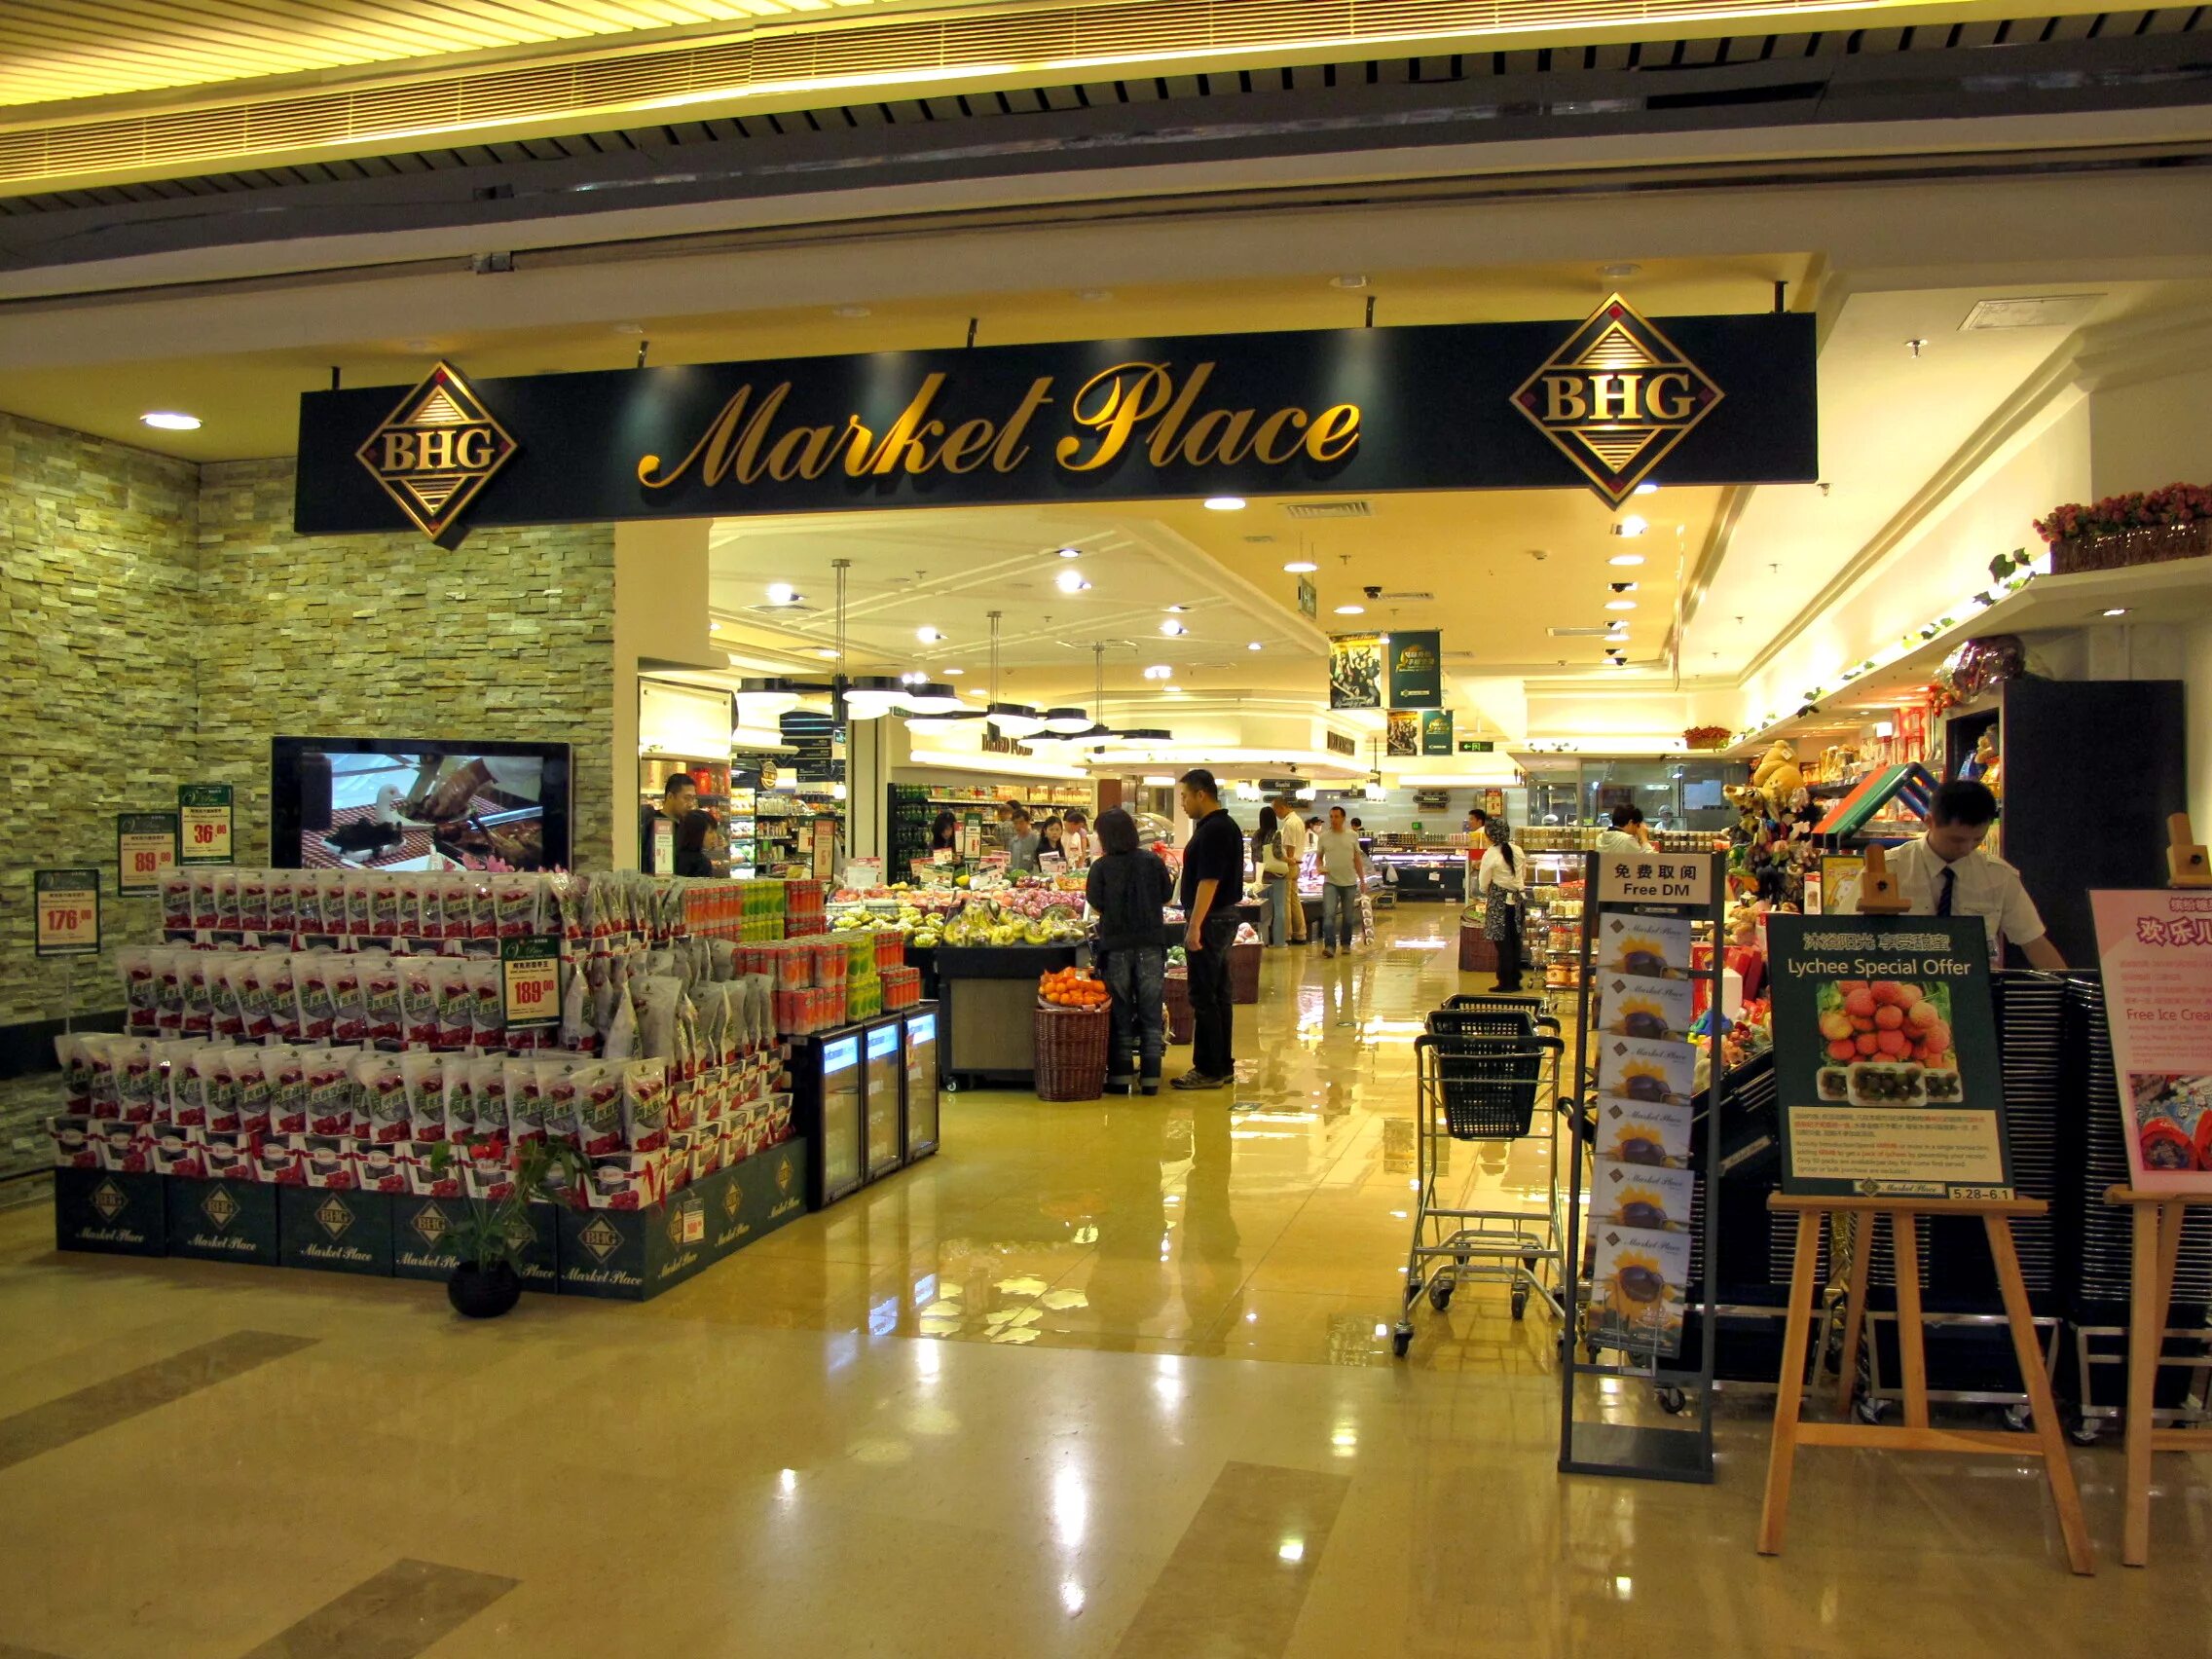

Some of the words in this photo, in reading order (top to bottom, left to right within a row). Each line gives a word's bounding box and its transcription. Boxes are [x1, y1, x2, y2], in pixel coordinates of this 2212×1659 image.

[1540, 373, 1697, 422] BHG
[638, 372, 1054, 488] Market
[1055, 361, 1361, 472] Place
[380, 426, 495, 474] BHG
[1614, 864, 1697, 880] 免费取阅
[1623, 883, 1657, 896] Free
[1663, 884, 1689, 896] DM
[1803, 932, 1876, 951] 沐浴阳光
[1877, 932, 1951, 951] 享受甜蜜
[1788, 958, 1848, 977] Lychee
[1855, 958, 1917, 977] Special
[1923, 958, 1972, 976] Offer
[2126, 1009, 2155, 1020] Free
[2158, 1009, 2177, 1020] Ice
[585, 1231, 617, 1245] BHG
[301, 1243, 344, 1258] Market
[440, 1255, 461, 1269] Pla
[562, 1268, 608, 1284] Market
[609, 1270, 644, 1286] Place
